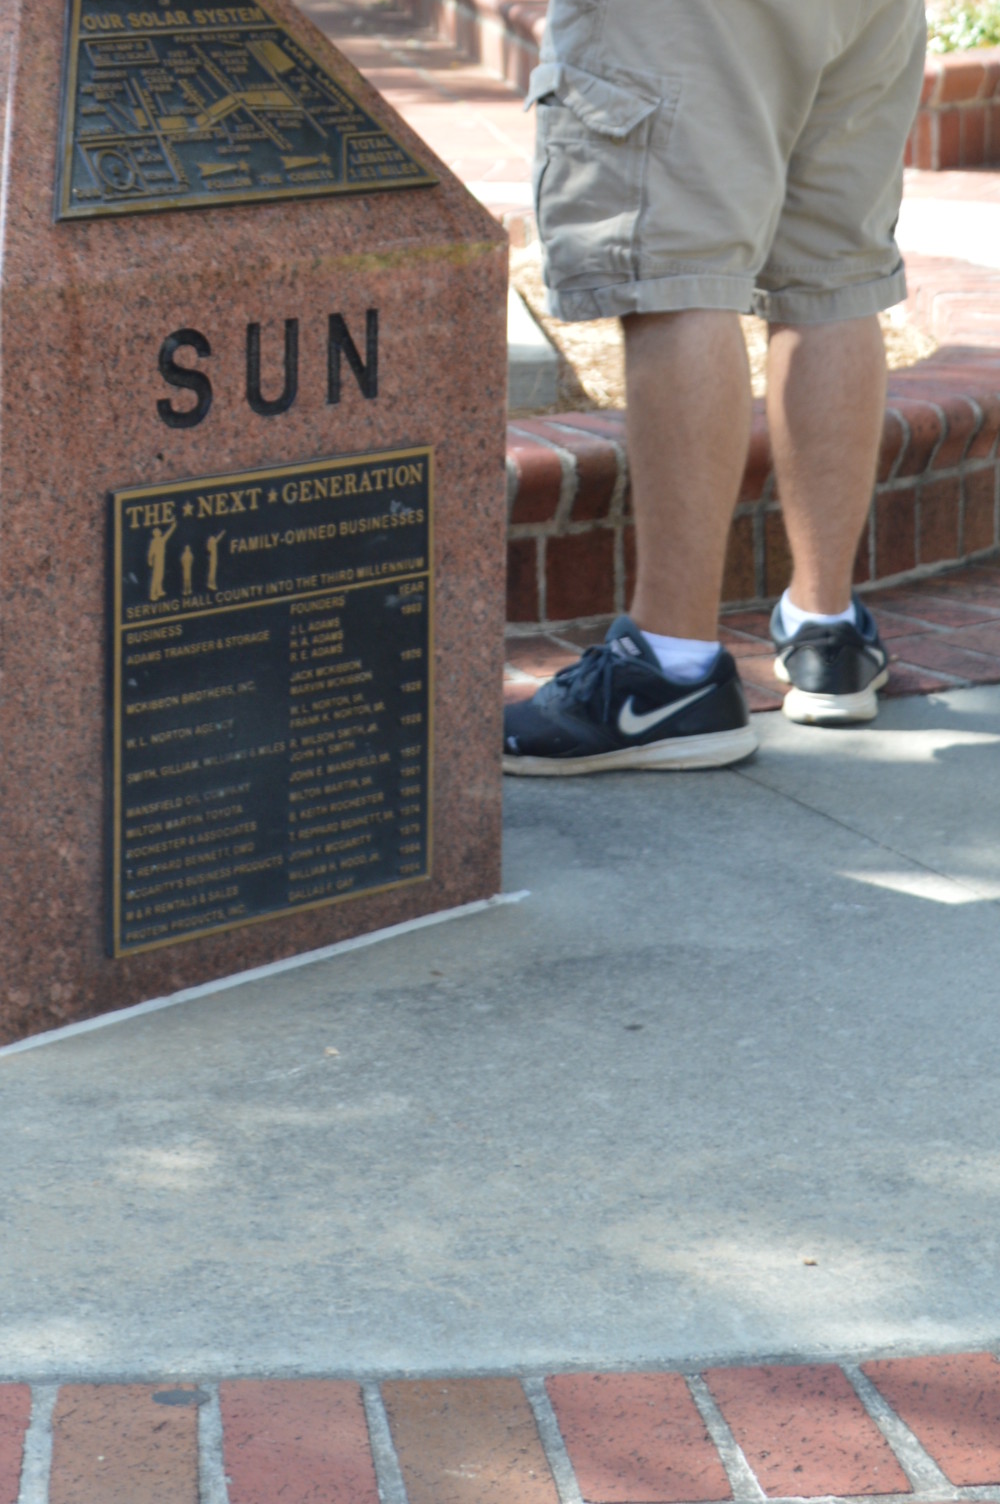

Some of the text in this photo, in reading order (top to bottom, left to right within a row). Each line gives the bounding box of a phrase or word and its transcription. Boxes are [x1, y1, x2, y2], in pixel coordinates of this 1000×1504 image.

[82, 7, 266, 30] OUR SOLAR SYSTEM
[156, 308, 379, 429] SUN
[126, 463, 424, 528] THE NEXT GENERATION
[230, 508, 424, 554] FAMILY-OWNED BUSINESSES
[126, 557, 424, 618] SERVING HALL COUNTY INTO THE THIRD MILLENNIUM
[398, 581, 425, 596] YEAR
[290, 596, 345, 615] FOUNDERS
[126, 624, 182, 644] BUSINESS
[308, 617, 340, 633] ADAMS
[126, 630, 270, 666] ADAMS TRANSFER & STORAGE
[312, 629, 344, 645] ADAMS
[311, 643, 343, 658] ADAMS
[151, 727, 192, 745] NORTON
[126, 797, 183, 818] MANSFIELD
[165, 814, 202, 831] MARTIN
[205, 804, 243, 820] TOYOTA
[126, 836, 186, 859] ROCHESTER
[197, 821, 257, 843] ASSOCIATES
